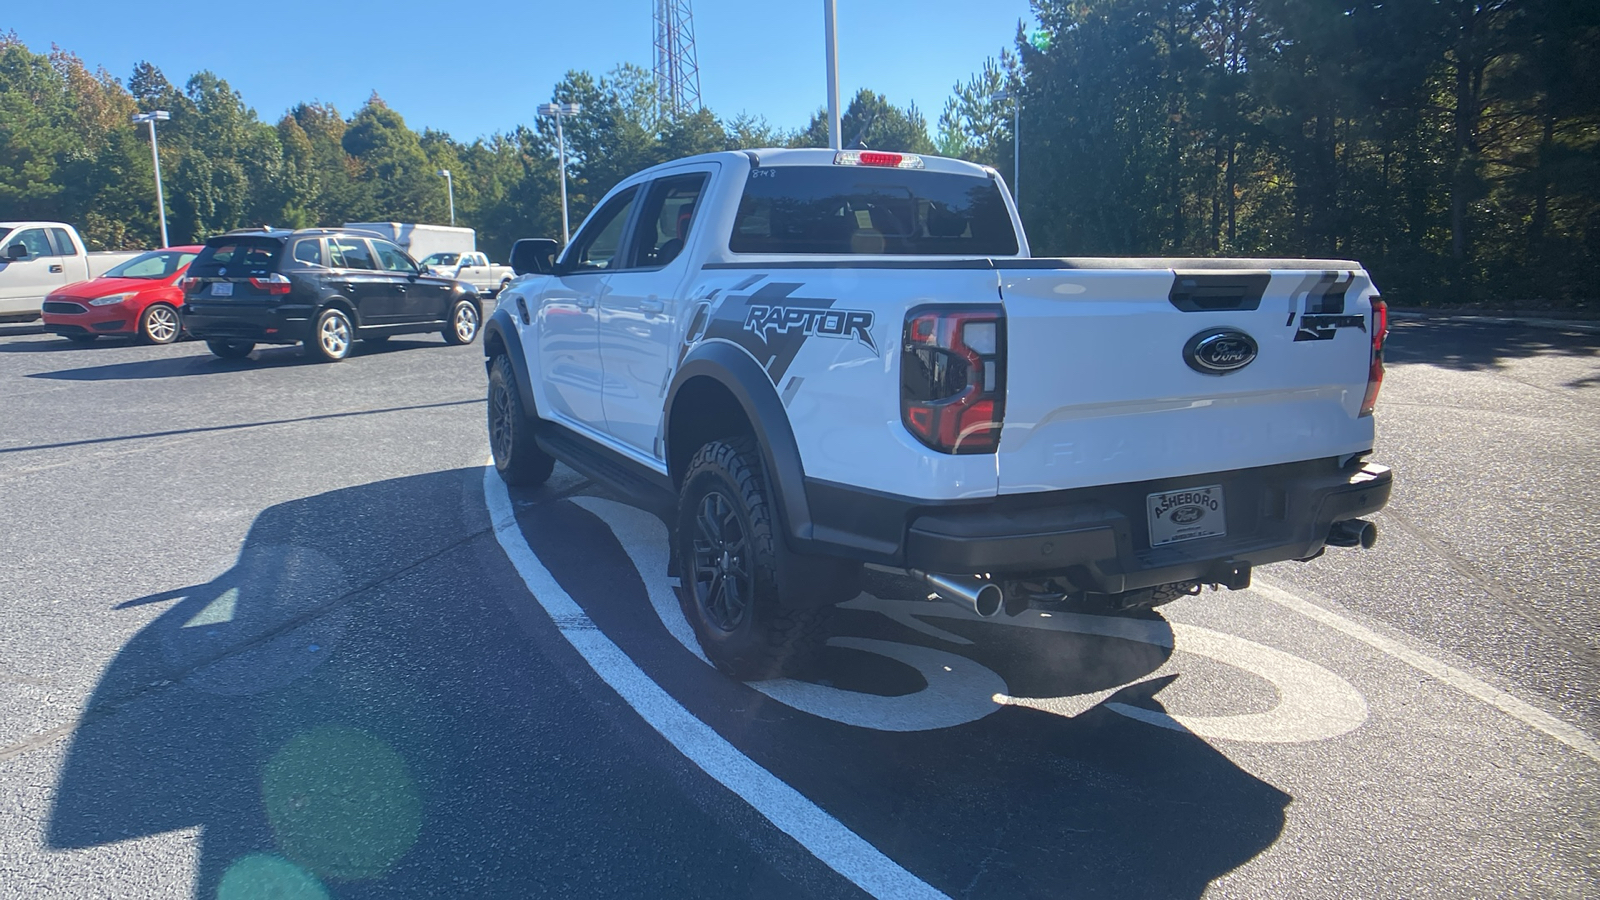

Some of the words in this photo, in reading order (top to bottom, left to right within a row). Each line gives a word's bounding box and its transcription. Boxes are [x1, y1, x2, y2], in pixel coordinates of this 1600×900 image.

[743, 305, 880, 358] RAPTOR
[1211, 341, 1247, 362] Ford
[1154, 492, 1218, 519] ASHEBORO
